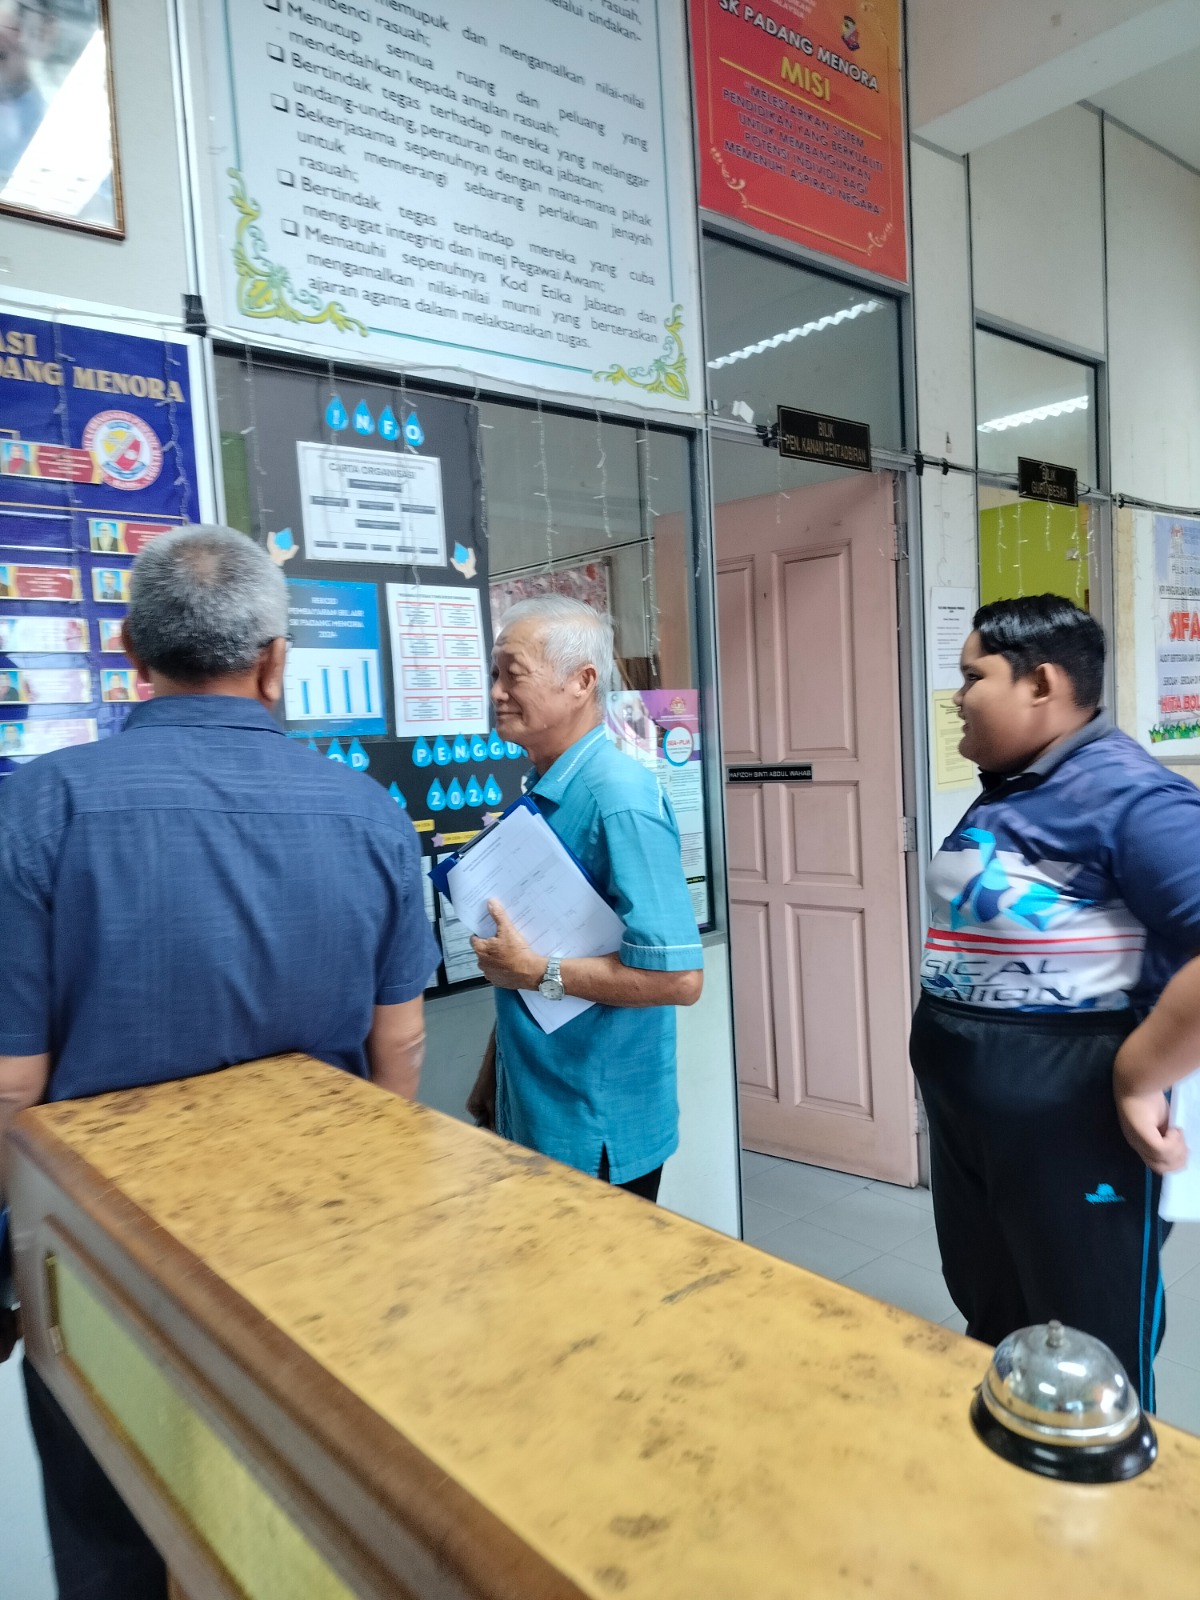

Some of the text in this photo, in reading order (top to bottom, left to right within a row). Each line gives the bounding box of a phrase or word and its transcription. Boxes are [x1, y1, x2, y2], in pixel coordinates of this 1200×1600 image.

[376, 16, 431, 48] rasuah;
[545, 0, 642, 41] elalui tindakan-
[743, 6, 814, 55] PADANG
[817, 46, 880, 93] MENORA
[287, 1, 649, 152] Menutup semua ruang dan peluang yang
[289, 31, 560, 138] mendedahkan kepada amalan rasuah;
[461, 26, 488, 47] dan
[499, 43, 585, 85] mengamalkan
[596, 81, 645, 110] nilai-nilai
[780, 56, 831, 102] MISI
[291, 52, 649, 188] Bertindak tegas terhadap mereka yang melanggar
[723, 88, 884, 171] PENDIDIKAN YANG BERKUALITI
[738, 112, 872, 182] UNTUK MEMBANGUNKAN
[832, 125, 865, 148] SISTEM
[296, 101, 653, 228] Bekerjasama sepenuhnya dengan mana-mana pihak
[297, 130, 653, 247] untuk memerangi sebarang perlakuan jenayah
[299, 155, 360, 183] rasuah;
[421, 124, 491, 155] peraturan
[495, 147, 518, 165] dan
[522, 157, 554, 177] etika
[557, 167, 604, 194] jabatan;
[724, 139, 787, 176] MEMENUHI
[790, 169, 835, 197] ASPIRASI
[744, 132, 868, 194] POTENSI INDIVIDU BAGI
[302, 176, 655, 287] Bertindak tegas terhadap mereka yang cuba
[303, 204, 606, 293] mengugat integriti dan imej Pegawai Awam;
[305, 225, 657, 325] Mematuhi sepenuhnya Kod Etika Jabatan dan
[307, 254, 658, 344] mengamalkan nilai-nilai murni yang berteraskan
[309, 278, 592, 350] ajaran agama dalam melaksanakan tugas.
[0, 355, 186, 403] ANG MENORA
[333, 409, 421, 439] INFO
[817, 421, 835, 439] BILIK
[431, 787, 497, 806] 2024
